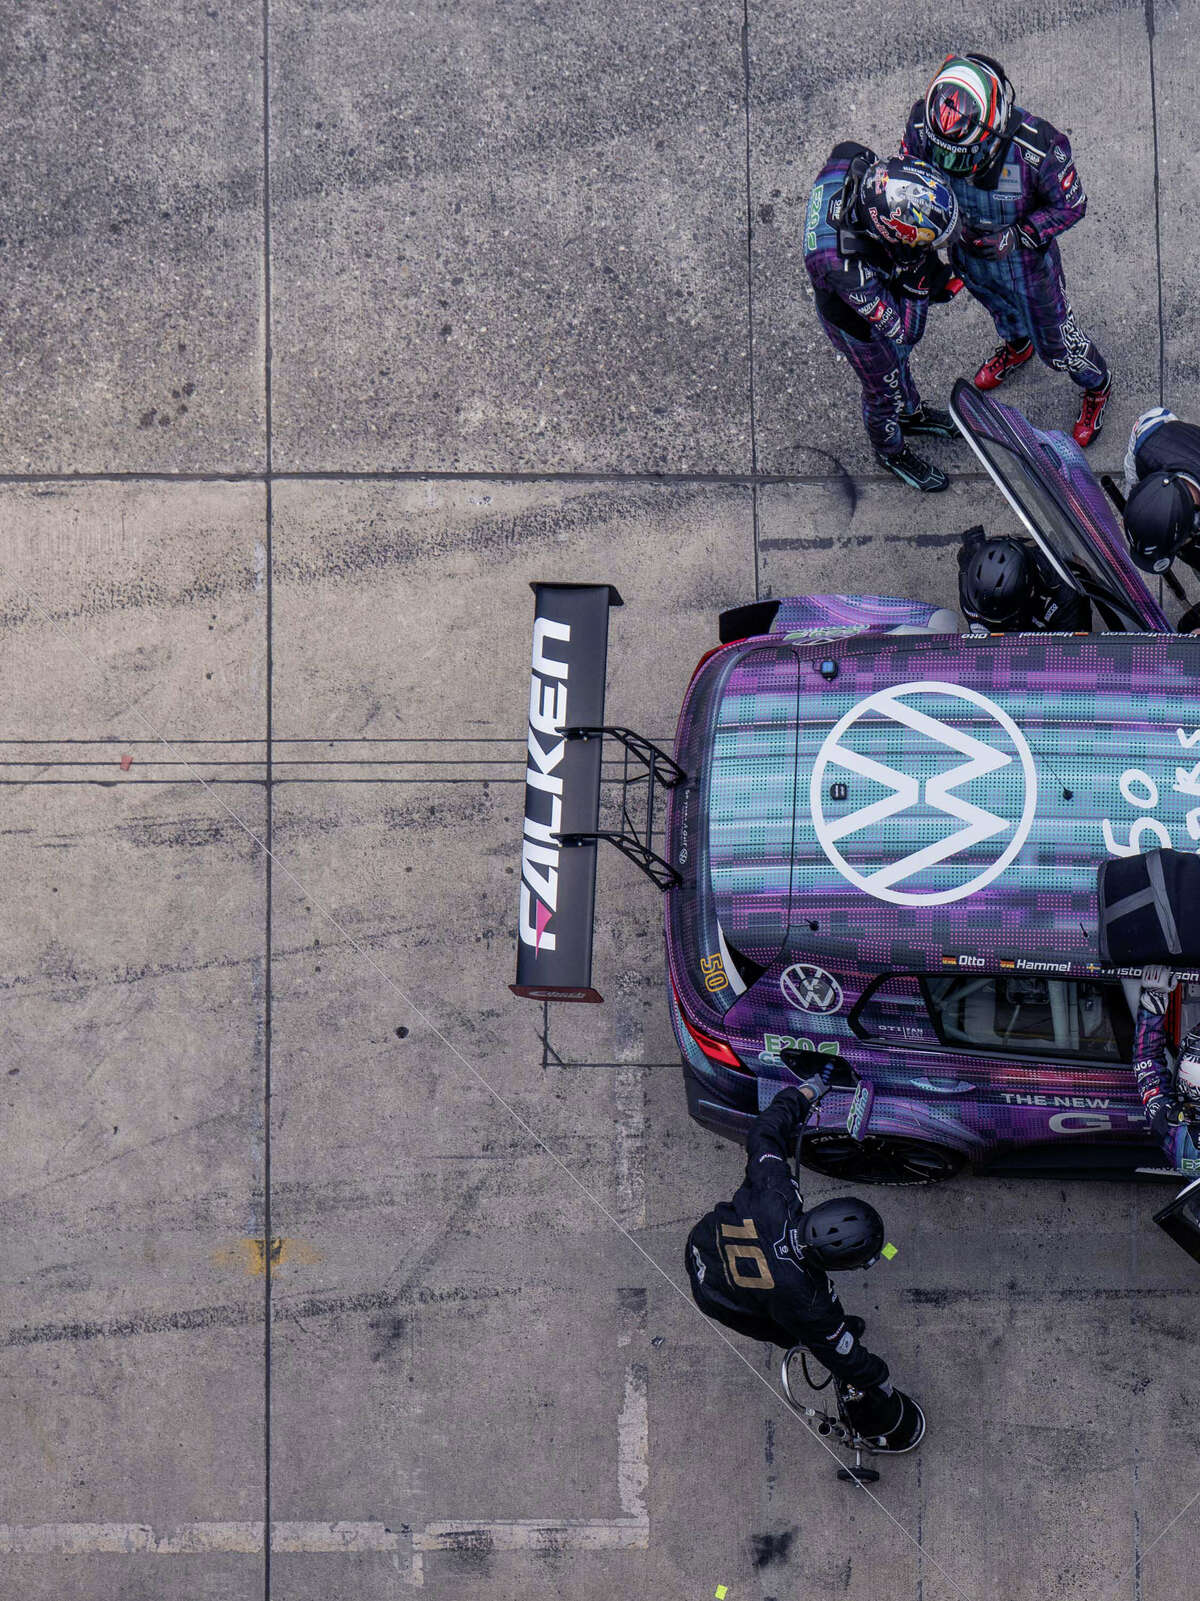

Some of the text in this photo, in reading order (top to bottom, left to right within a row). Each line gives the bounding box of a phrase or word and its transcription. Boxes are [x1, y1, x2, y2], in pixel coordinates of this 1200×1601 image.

[519, 616, 572, 956] FALKEN
[958, 954, 986, 967] Otto
[1015, 958, 1072, 973] Hammel
[700, 952, 729, 993] 50
[764, 1033, 815, 1053] E20
[1000, 1093, 1111, 1109] THE NEW
[720, 1218, 775, 1290] 10
